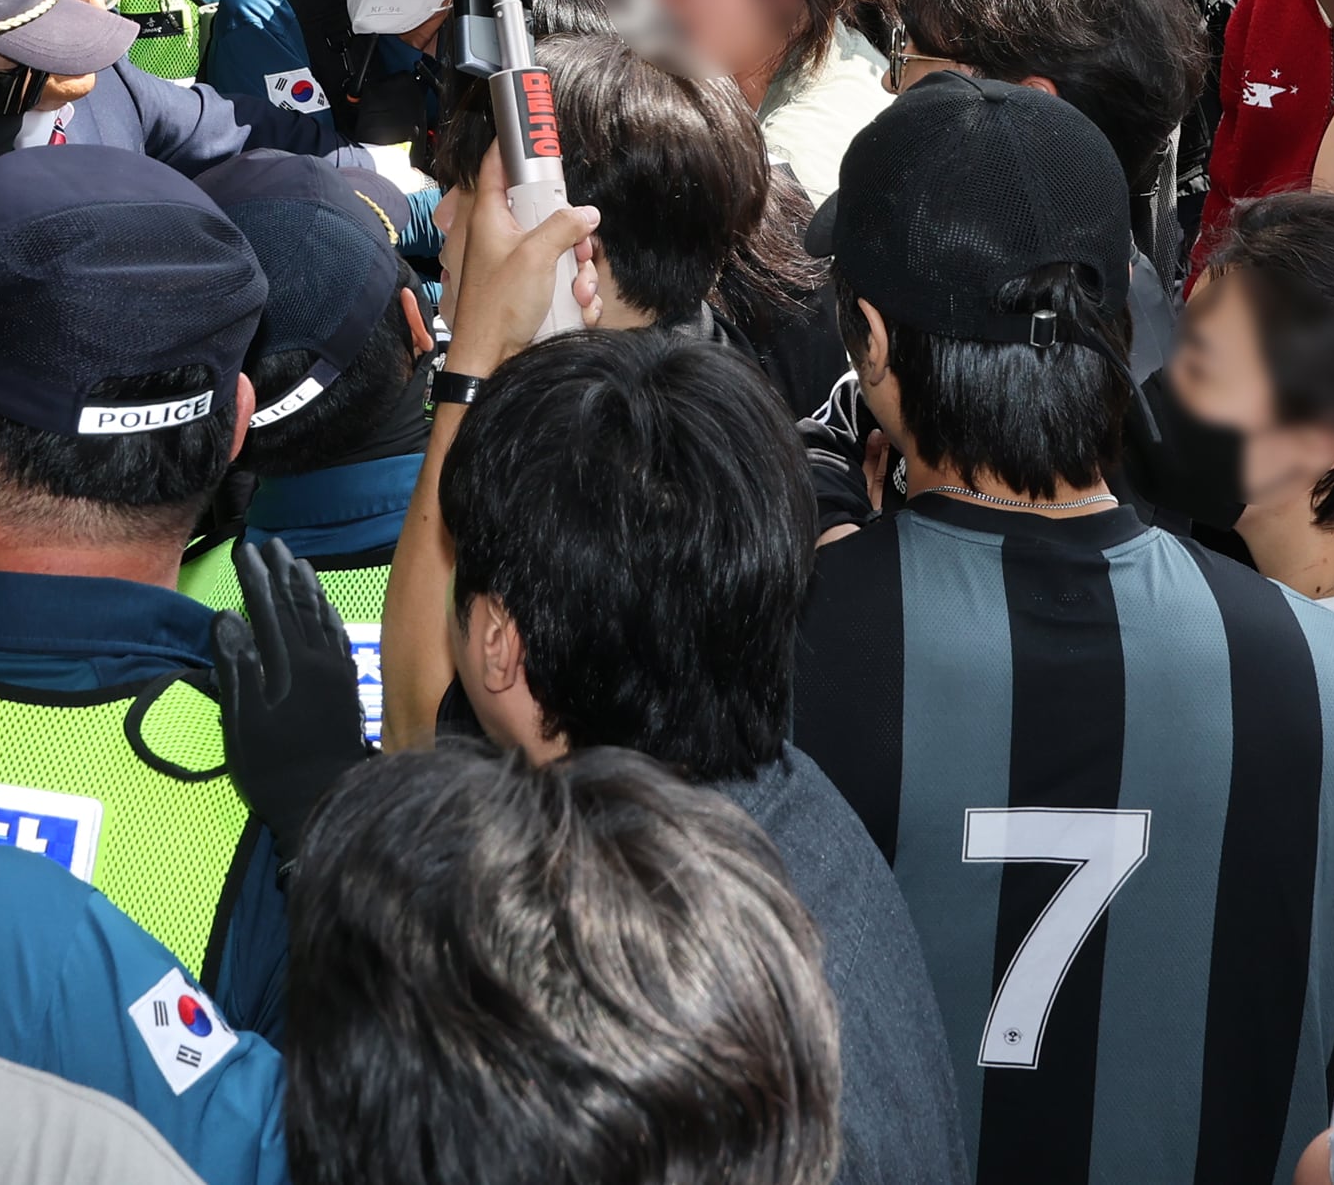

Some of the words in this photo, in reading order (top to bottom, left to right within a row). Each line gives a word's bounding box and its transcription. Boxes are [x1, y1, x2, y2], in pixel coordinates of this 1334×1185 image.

[370, 5, 401, 13] KF-94
[97, 396, 208, 428] POLICE
[962, 807, 1152, 1070] 7
